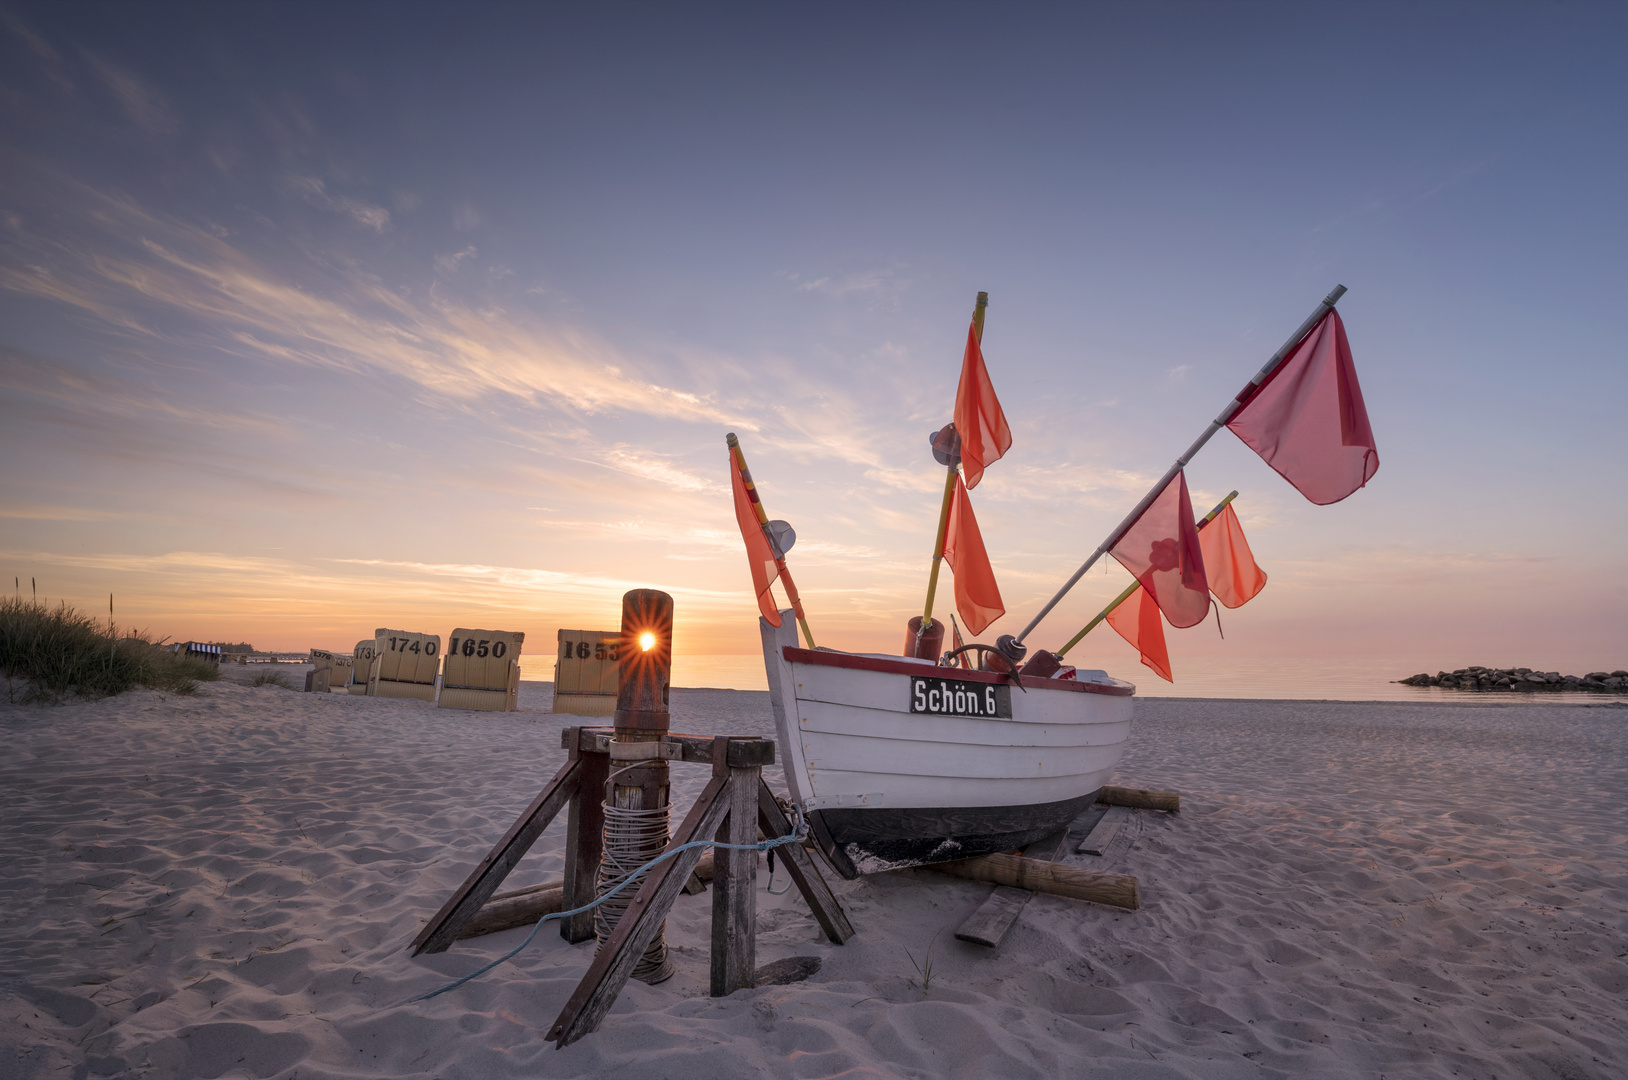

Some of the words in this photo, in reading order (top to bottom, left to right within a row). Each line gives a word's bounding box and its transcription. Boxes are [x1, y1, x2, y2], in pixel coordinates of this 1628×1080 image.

[313, 651, 332, 660] 1376
[389, 636, 436, 656] 1740
[450, 637, 507, 658] 1650
[914, 680, 996, 715] Schön.6
